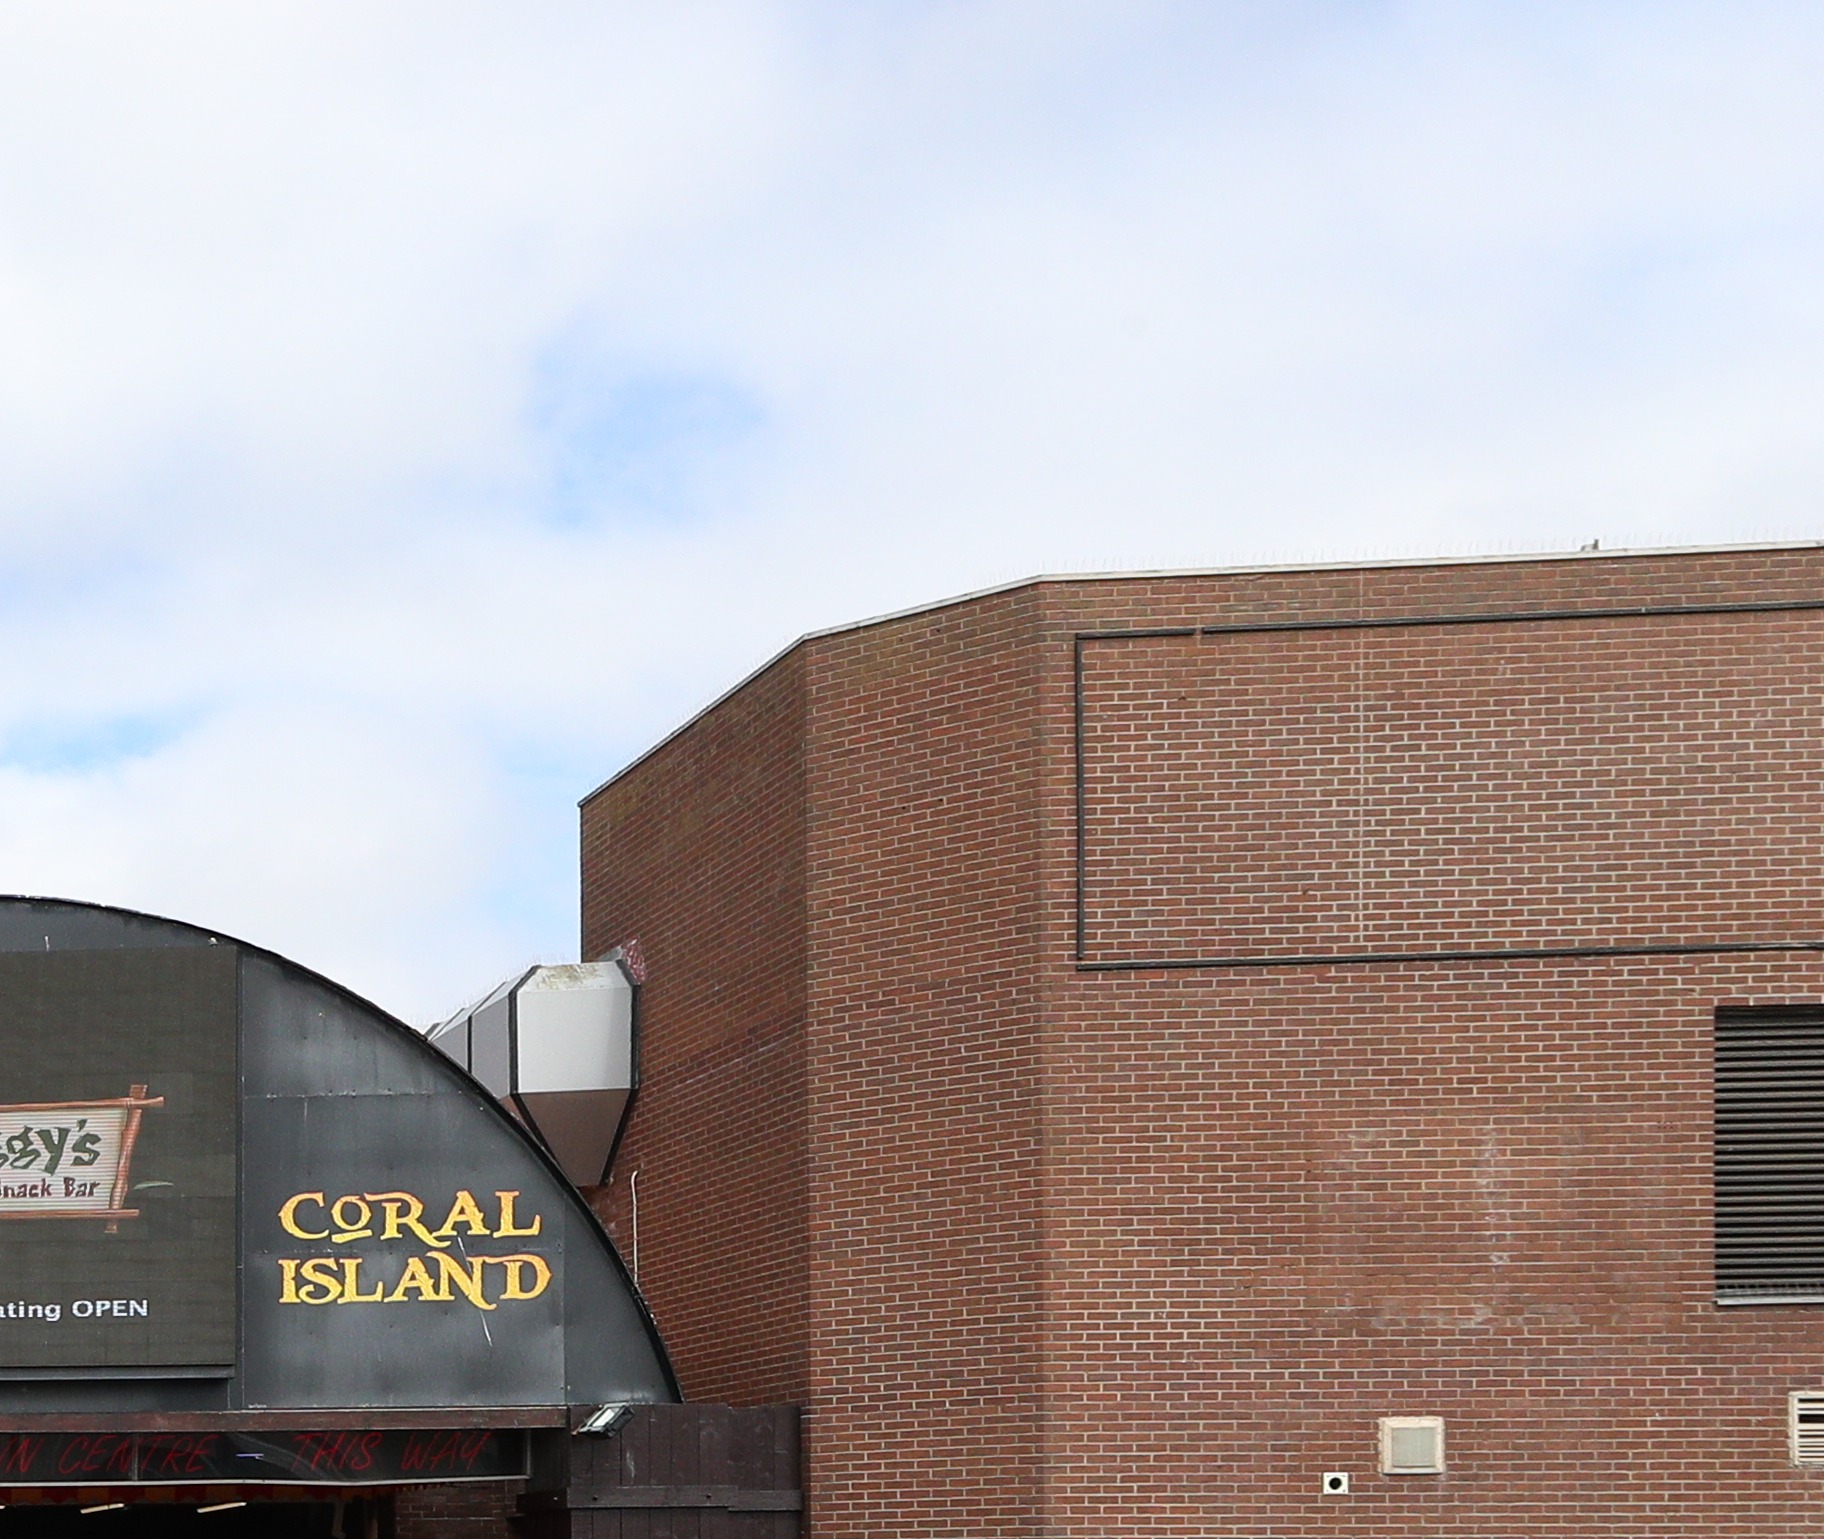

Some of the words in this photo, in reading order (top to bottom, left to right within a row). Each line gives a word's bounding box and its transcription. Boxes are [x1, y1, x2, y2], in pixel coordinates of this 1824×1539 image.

[63, 1177, 101, 1199] Bar
[278, 1190, 542, 1248] CORAL
[278, 1250, 552, 1310] ISLAND
[71, 1299, 148, 1318] OPEN
[57, 1433, 219, 1475] CENTRE
[291, 1432, 383, 1474] THIS
[400, 1431, 493, 1470] WAY
